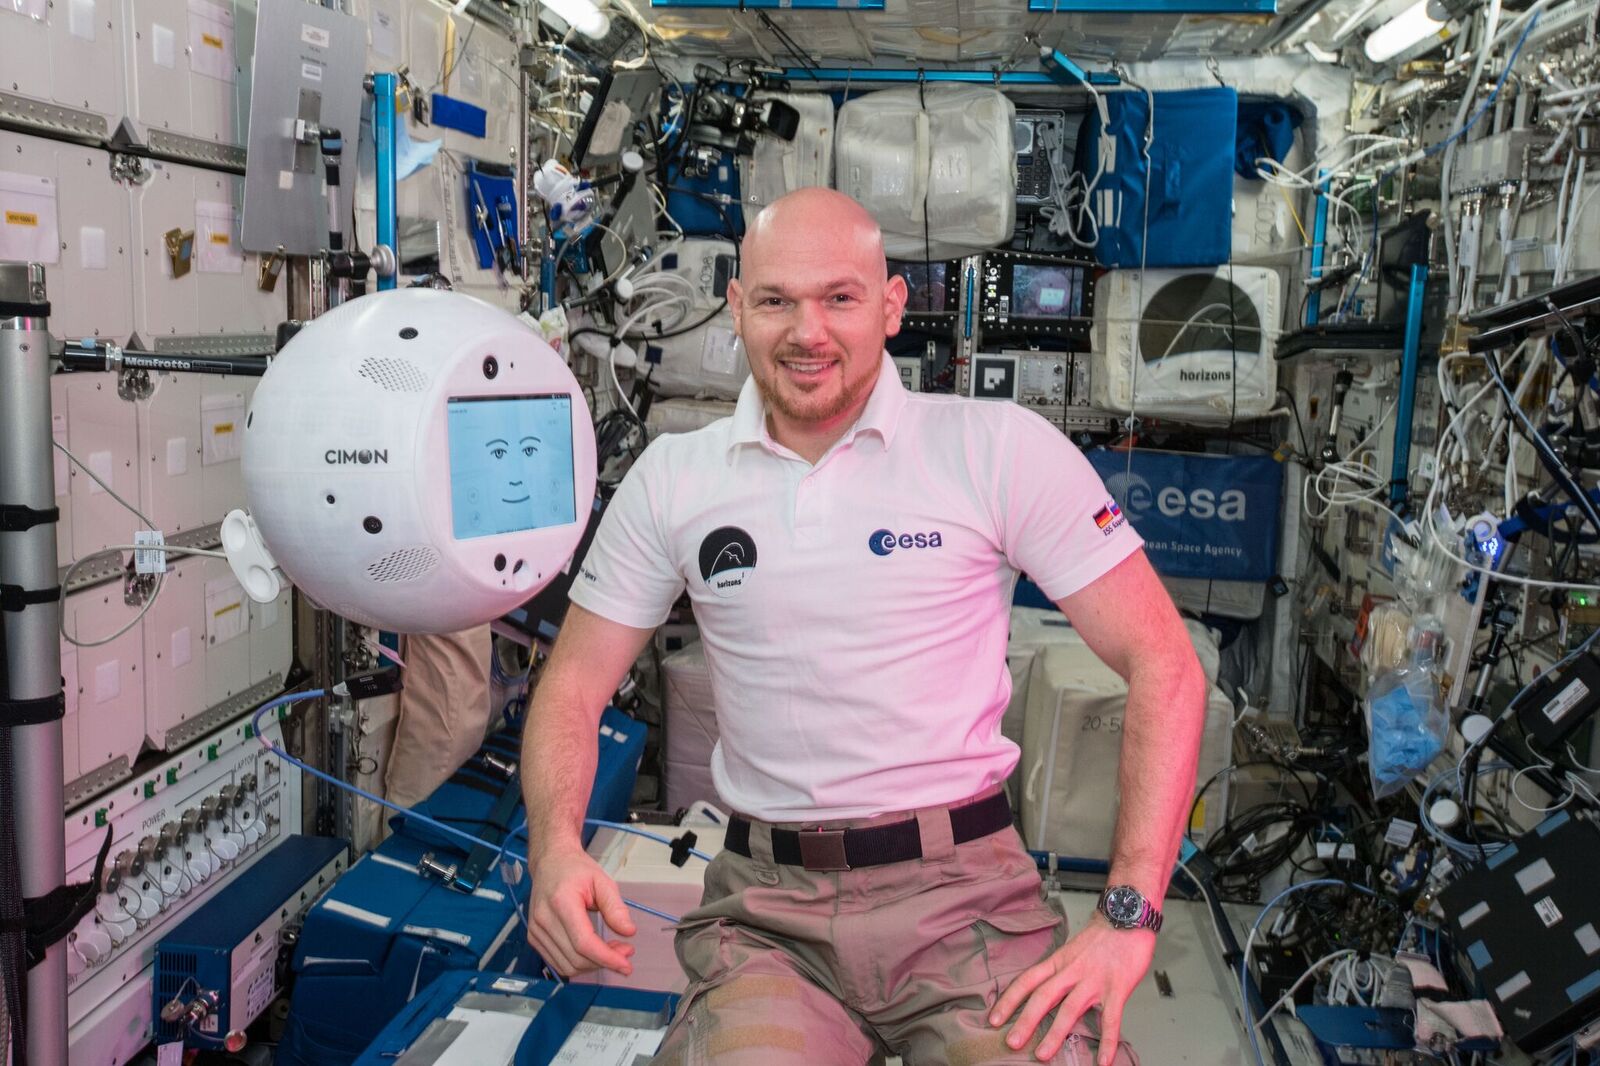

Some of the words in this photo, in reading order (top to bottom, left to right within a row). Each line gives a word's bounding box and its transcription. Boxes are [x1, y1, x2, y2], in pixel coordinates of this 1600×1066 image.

[124, 357, 191, 369] Manfrotto
[1180, 368, 1231, 381] horizons
[325, 449, 388, 464] CIMON
[1157, 486, 1246, 521] esa
[898, 531, 942, 549] esa
[1171, 540, 1200, 552] Space
[1204, 543, 1242, 558] Agency
[717, 579, 742, 588] horizons
[142, 808, 167, 830] POWER
